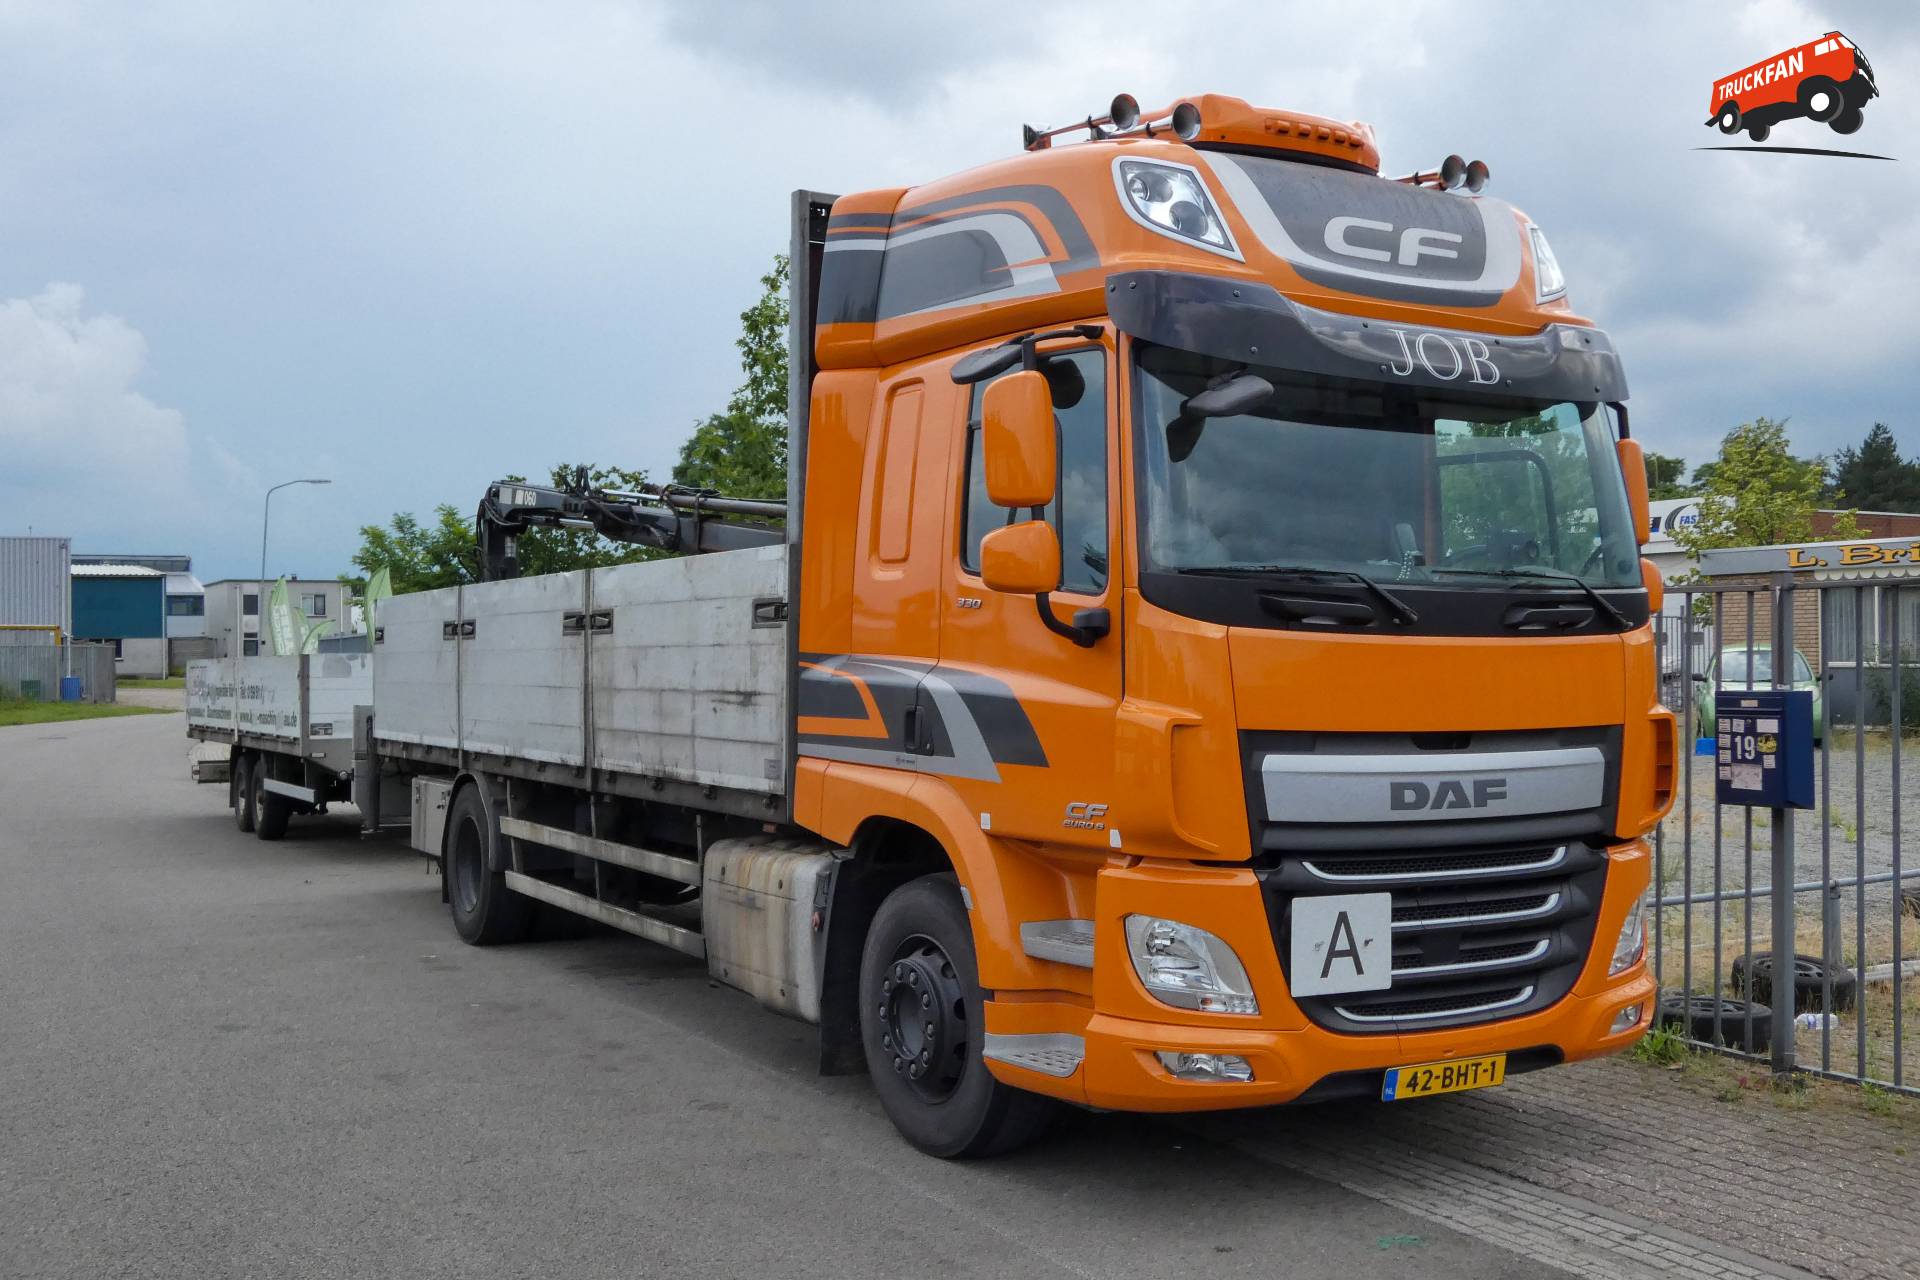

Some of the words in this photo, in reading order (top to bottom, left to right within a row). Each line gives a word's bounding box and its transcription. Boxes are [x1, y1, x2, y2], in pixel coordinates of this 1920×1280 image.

[1324, 216, 1462, 266] CF
[1387, 329, 1500, 385] JOB
[1680, 515, 1698, 525] FAS
[1786, 549, 1828, 568] L.
[957, 597, 982, 609] 330
[1735, 736, 1755, 760] 19
[1390, 778, 1507, 811] DAF
[1066, 802, 1108, 820] CF
[1063, 819, 1094, 830] EURO
[1320, 911, 1365, 979] A
[1406, 1060, 1497, 1093] 42-BHT-1
